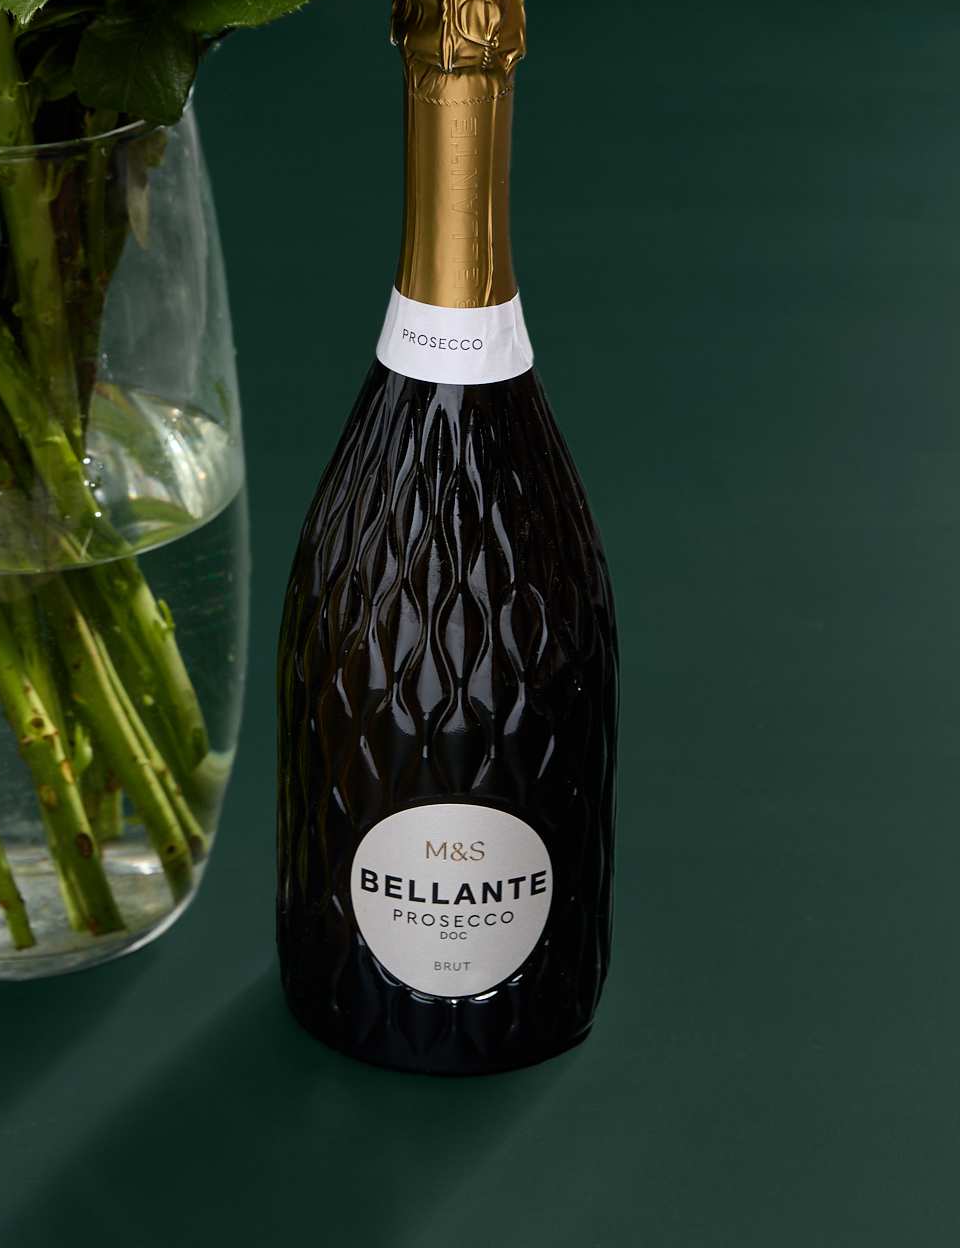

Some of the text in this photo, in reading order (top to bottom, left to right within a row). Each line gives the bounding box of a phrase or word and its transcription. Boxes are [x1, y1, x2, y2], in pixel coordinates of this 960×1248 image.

[401, 328, 483, 351] PROSECCO
[425, 840, 486, 861] M&S
[360, 867, 547, 905] BELLANTE
[393, 909, 514, 928] PROSECCO
[440, 931, 468, 940] DOC
[434, 961, 471, 972] BRUT
